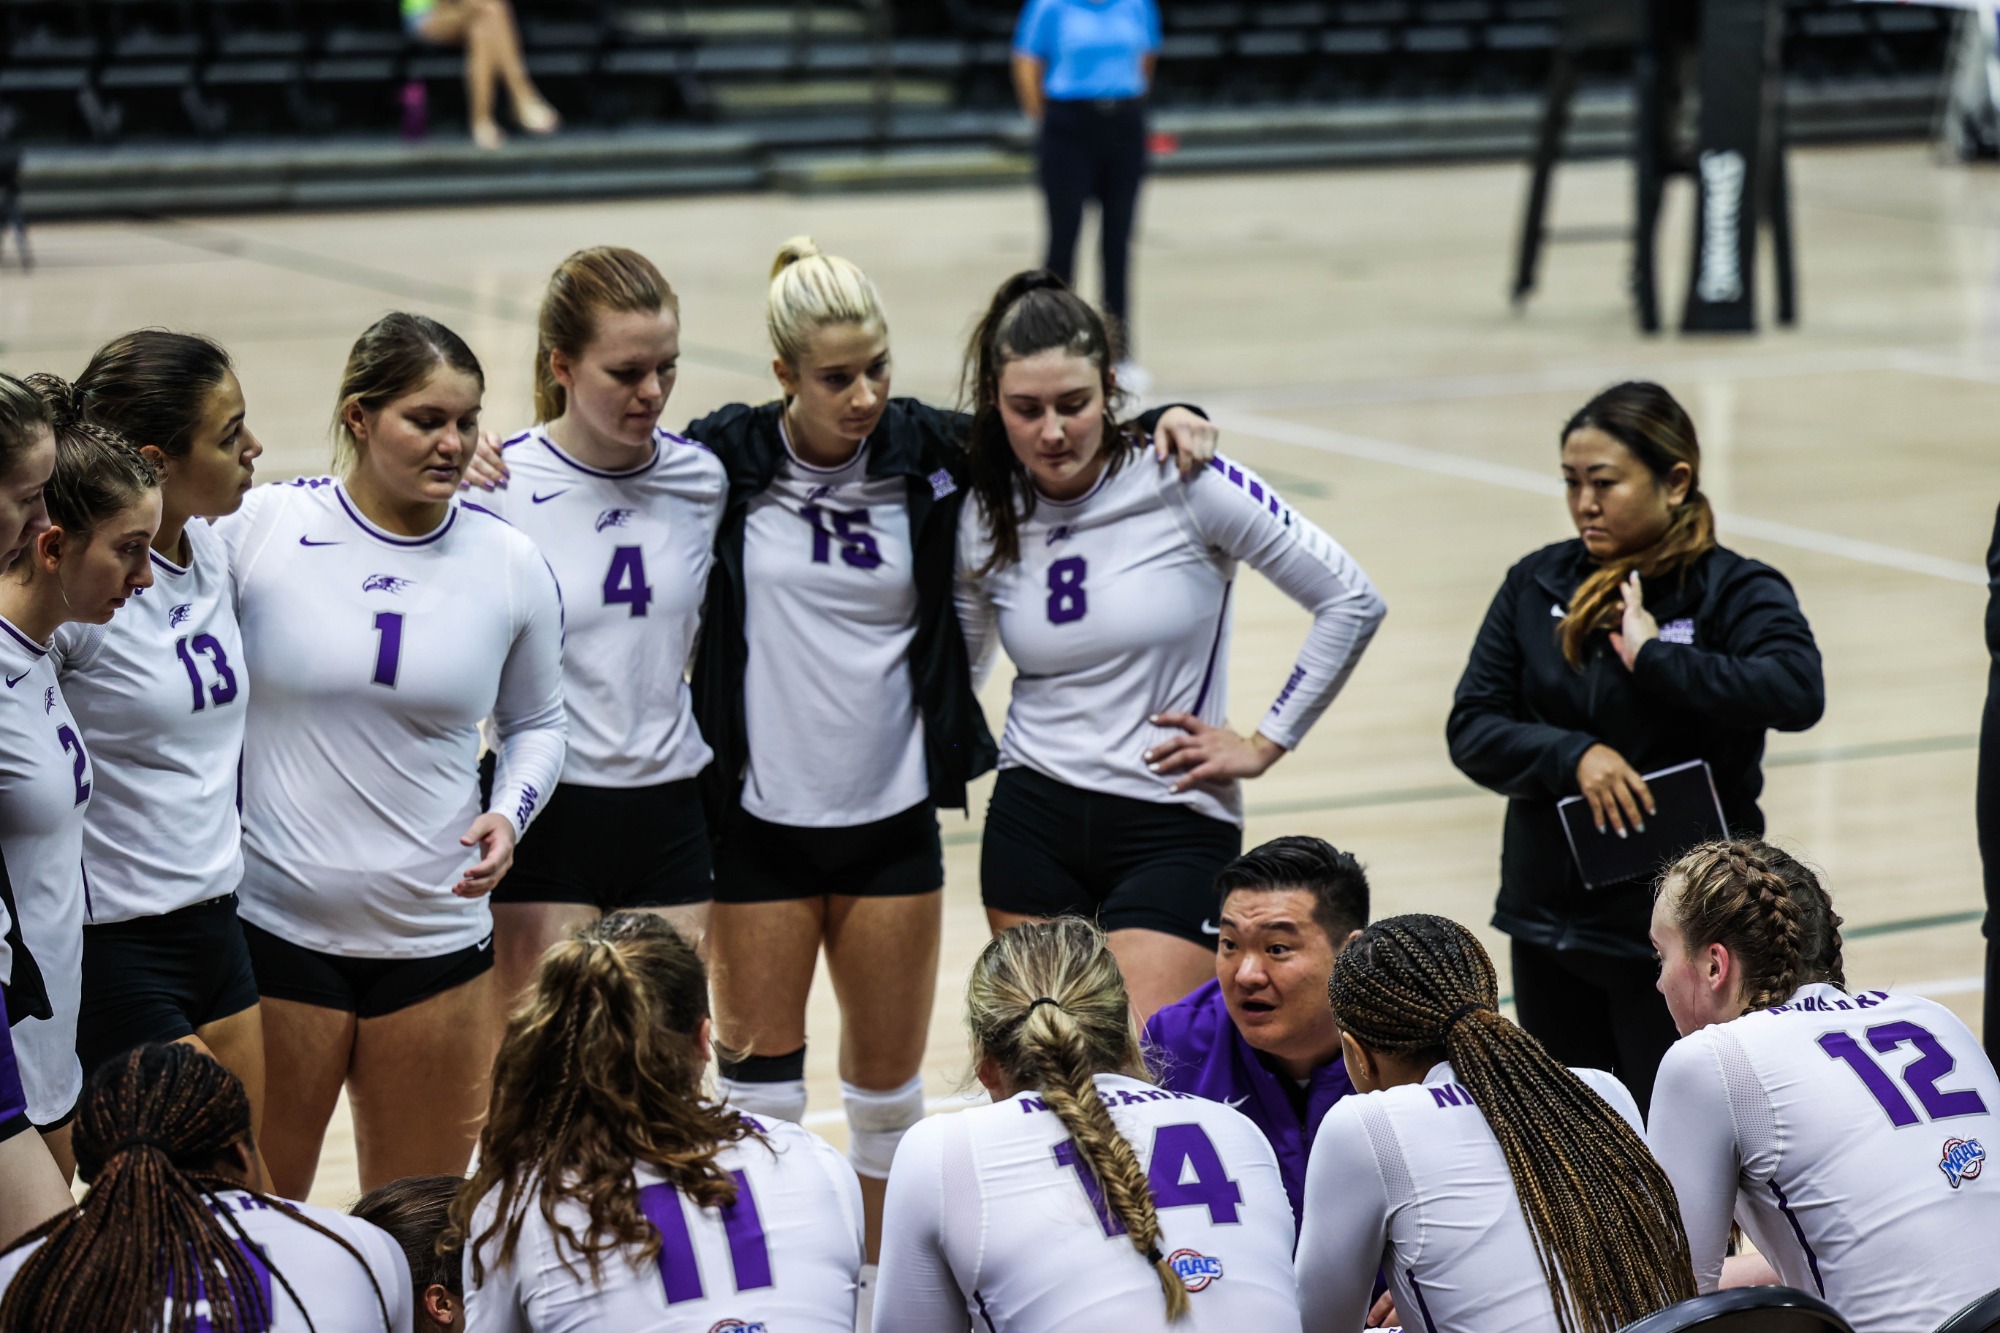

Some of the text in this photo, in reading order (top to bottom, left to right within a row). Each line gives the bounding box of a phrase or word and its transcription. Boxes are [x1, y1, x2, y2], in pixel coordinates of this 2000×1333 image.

[799, 505, 882, 571] 15
[601, 544, 653, 618] 4
[1045, 555, 1088, 626] 8
[176, 632, 238, 713] 13
[371, 611, 405, 689] 1
[56, 723, 91, 809] 2
[1814, 1019, 1990, 1130] 12
[1941, 1140, 1984, 1184] MAAC
[635, 1167, 777, 1308] 11
